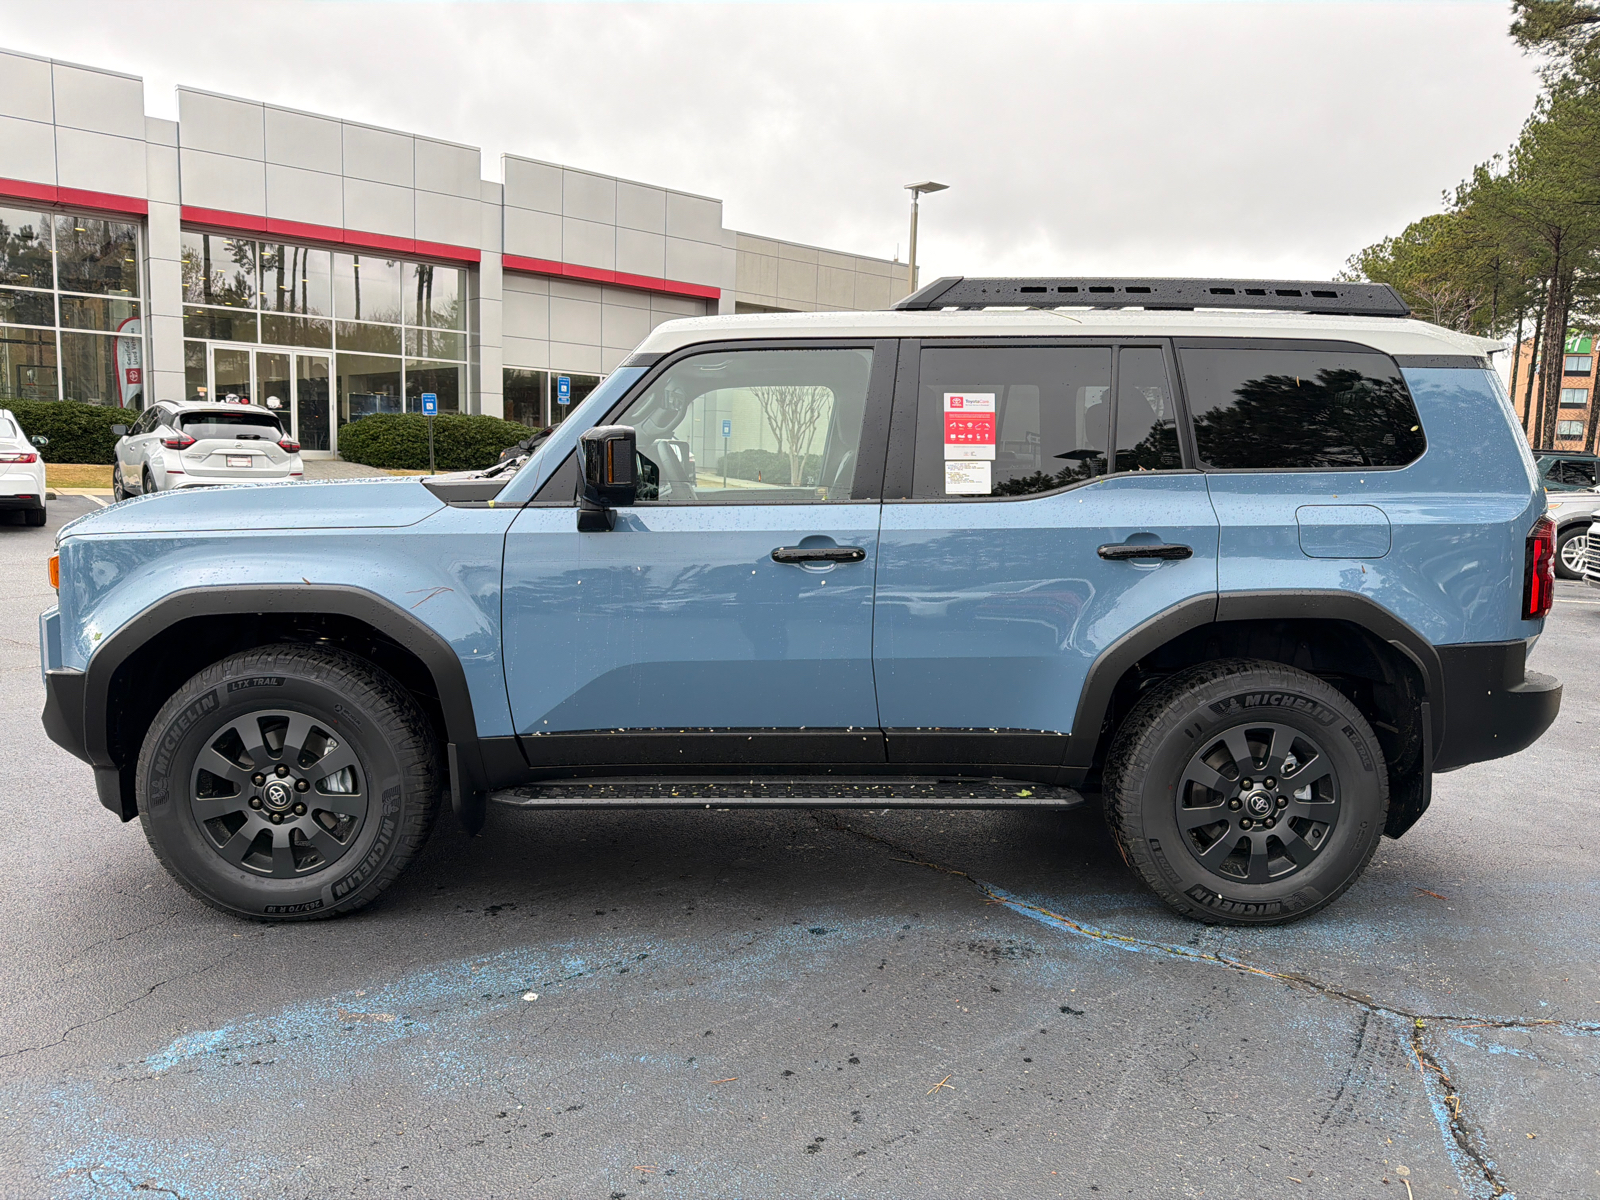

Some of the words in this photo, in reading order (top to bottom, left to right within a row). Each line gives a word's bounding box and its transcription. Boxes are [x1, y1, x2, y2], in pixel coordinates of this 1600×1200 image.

[231, 680, 250, 691] LTX
[253, 678, 278, 686] TRAIL
[1244, 693, 1334, 723] MICHELIN
[155, 694, 216, 774] MICHELIN
[335, 818, 396, 897] MICHELIN
[1191, 888, 1282, 915] MICHELIN
